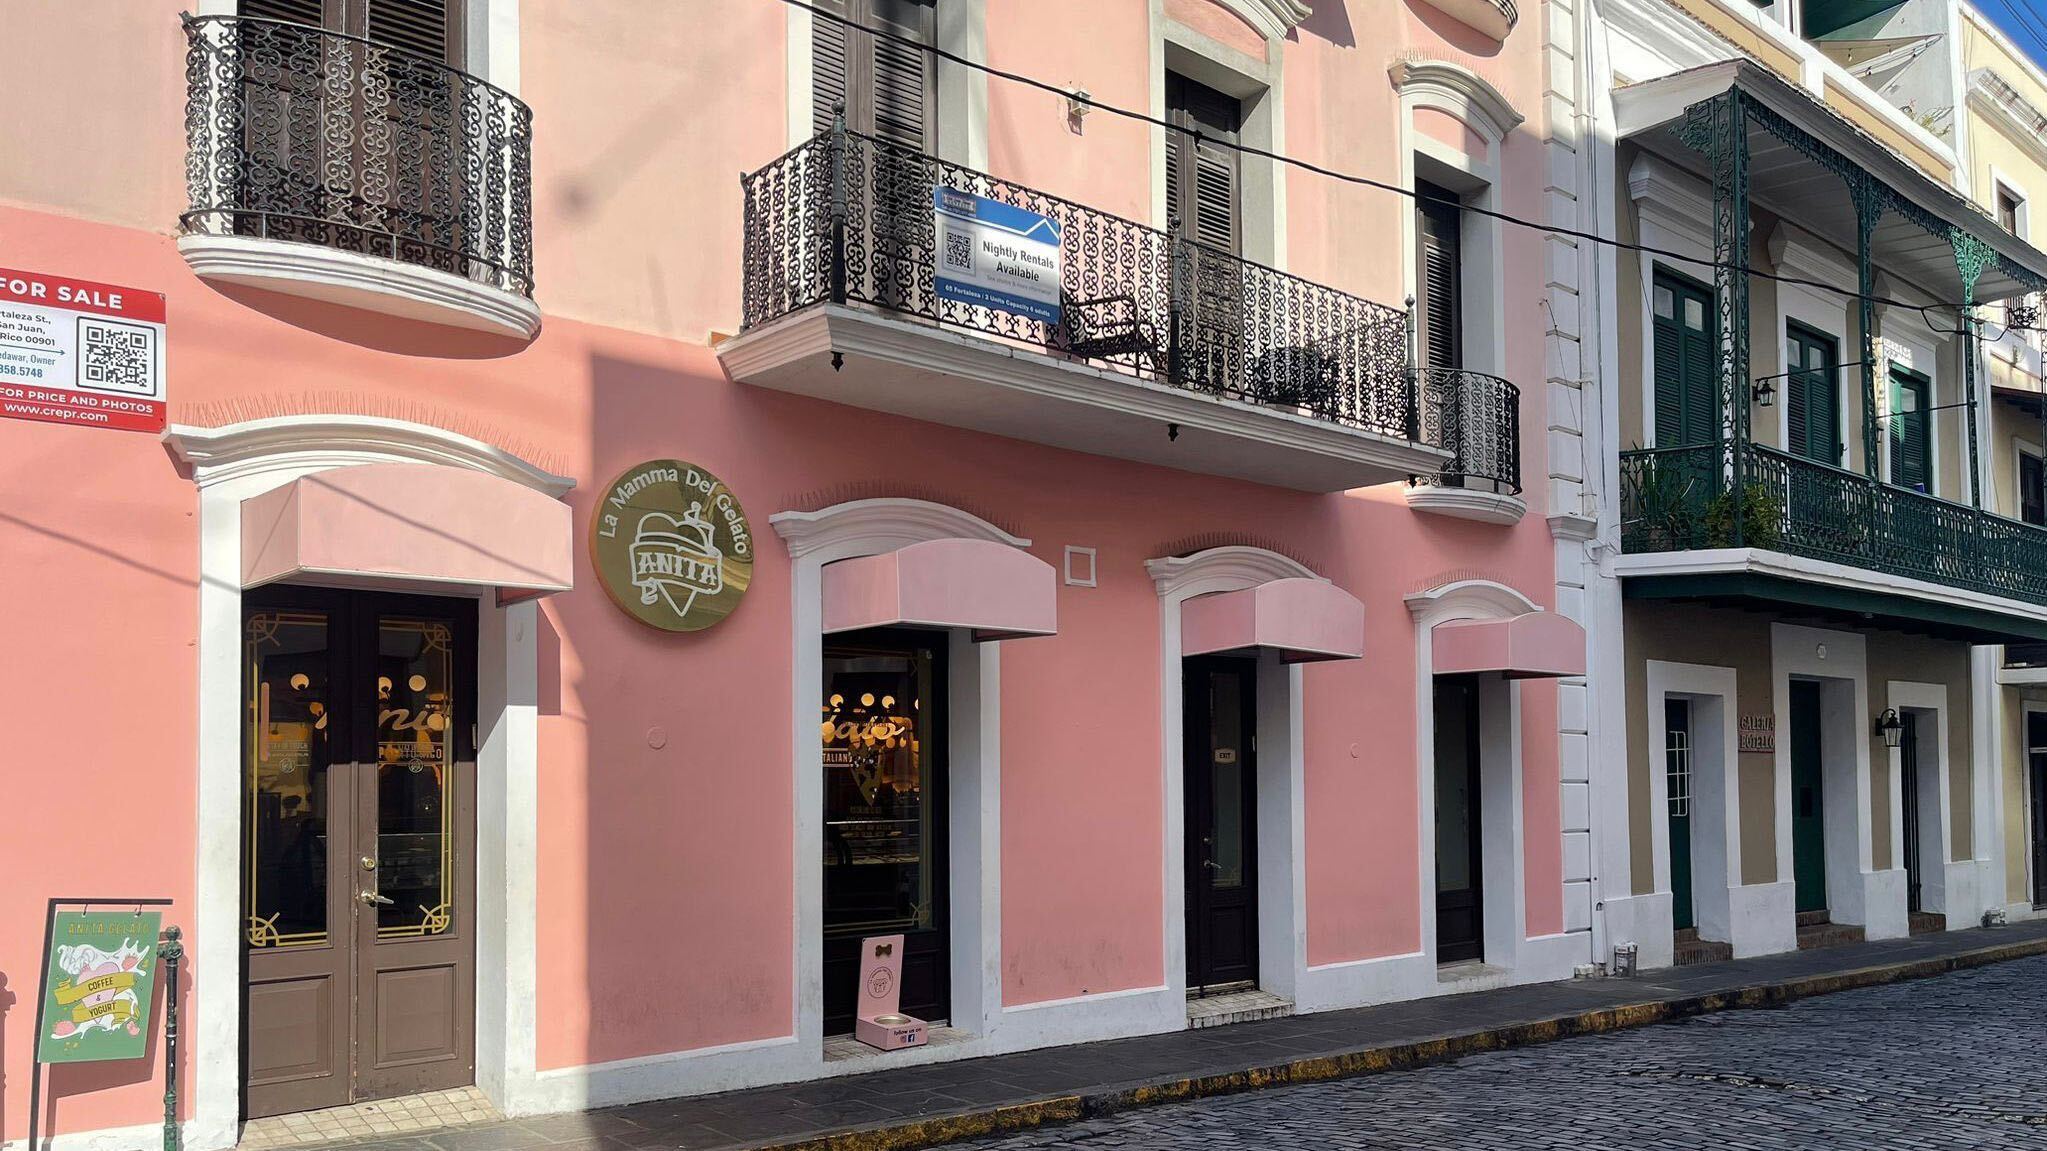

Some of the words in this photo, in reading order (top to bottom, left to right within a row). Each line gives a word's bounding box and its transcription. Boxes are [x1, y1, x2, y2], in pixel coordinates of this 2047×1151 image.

[983, 241, 1017, 261] Nightly
[1020, 250, 1054, 269] Rentals
[996, 262, 1039, 281] Available
[0, 277, 46, 298] FOR
[57, 286, 122, 310] SALE
[1006, 300, 1029, 312] Capacity
[0, 311, 33, 321] taleza
[17, 323, 46, 335] Juan,
[0, 332, 23, 342] Rico
[25, 335, 55, 346] 00901
[0, 350, 28, 363] dawar,
[30, 354, 56, 366] Owner
[0, 387, 24, 398] FOR
[28, 391, 66, 403] PRICE
[70, 396, 98, 407] AND
[102, 399, 153, 414] PHOTOS
[4, 403, 109, 422] www.crepr.com
[609, 468, 678, 509] Mamma
[685, 469, 718, 496] Del
[600, 513, 619, 538] La
[716, 494, 747, 554] Gelato
[637, 552, 717, 586] ANITA
[823, 753, 848, 763] TALIAN
[88, 976, 114, 991] COFFEE
[89, 1002, 117, 1017] YOGURT
